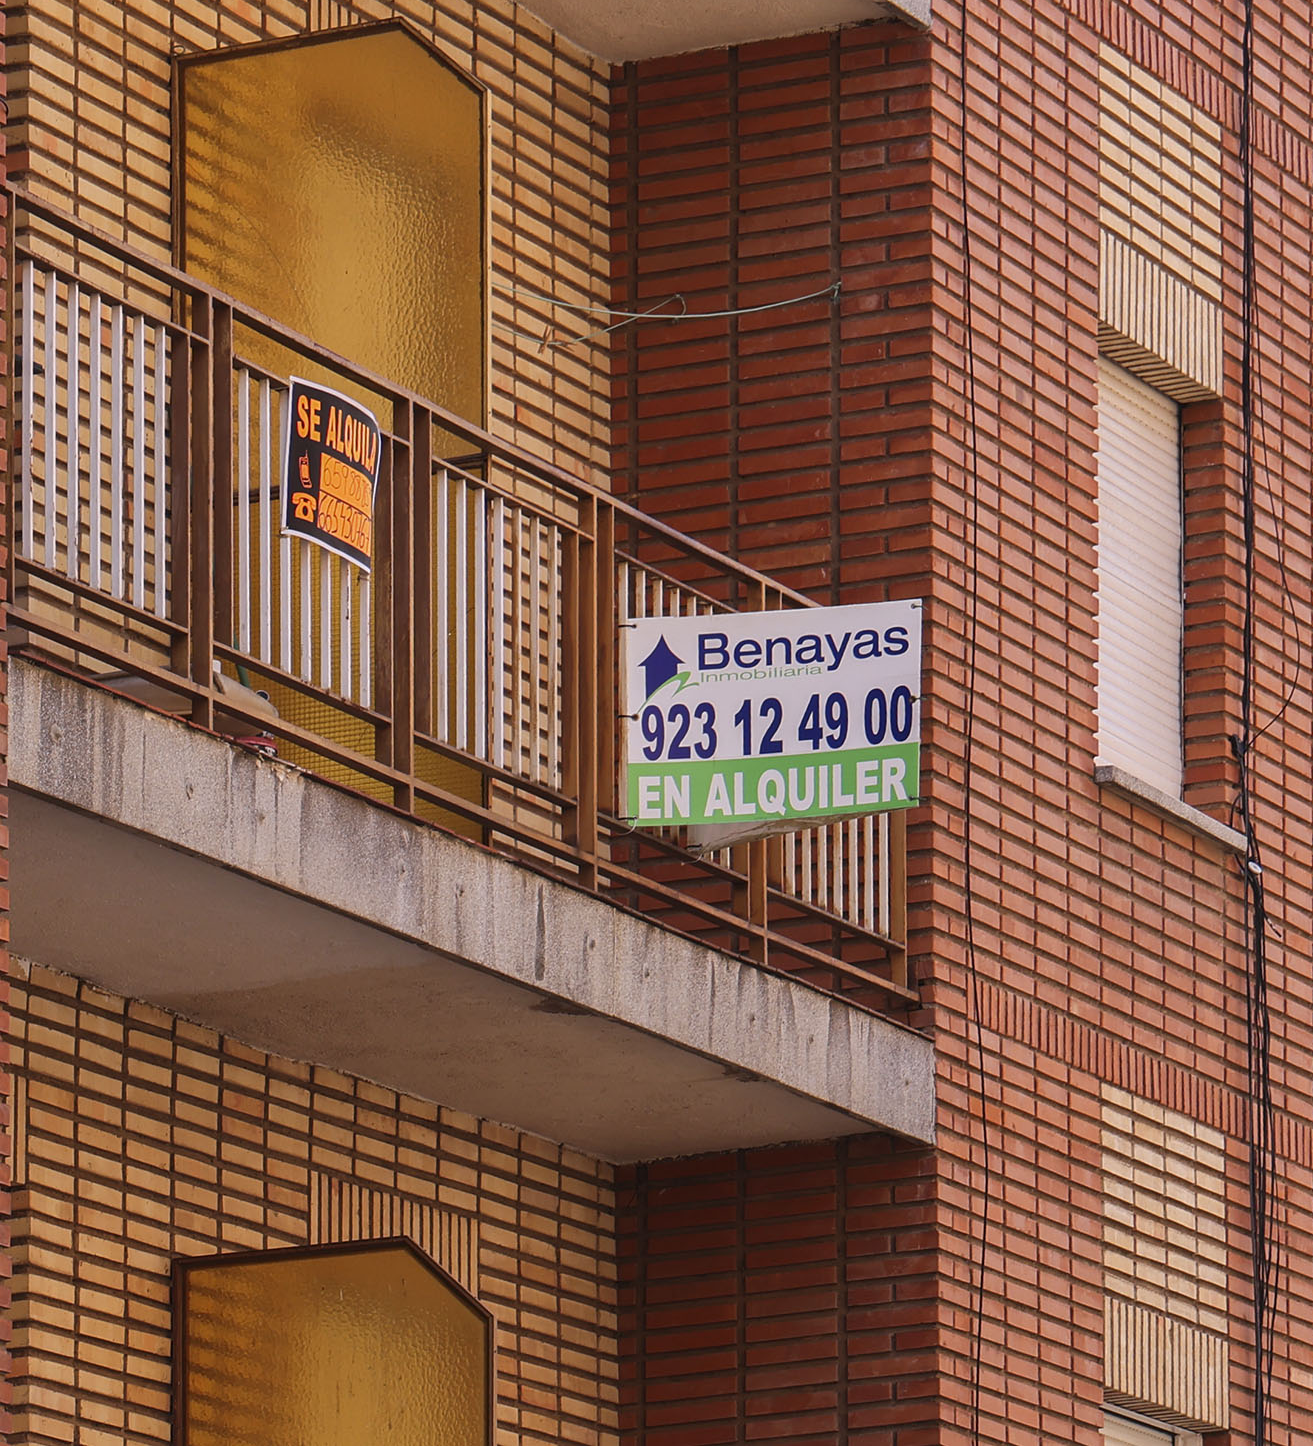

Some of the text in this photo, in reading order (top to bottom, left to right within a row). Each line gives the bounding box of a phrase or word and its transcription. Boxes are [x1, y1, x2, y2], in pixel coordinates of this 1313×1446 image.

[296, 394, 377, 475] SE ALQUILA
[697, 625, 909, 671] Benayas
[700, 665, 822, 683] Inmobiliaria
[642, 685, 913, 761] 923 12 49 00
[638, 758, 908, 819] EN ALQUILER
